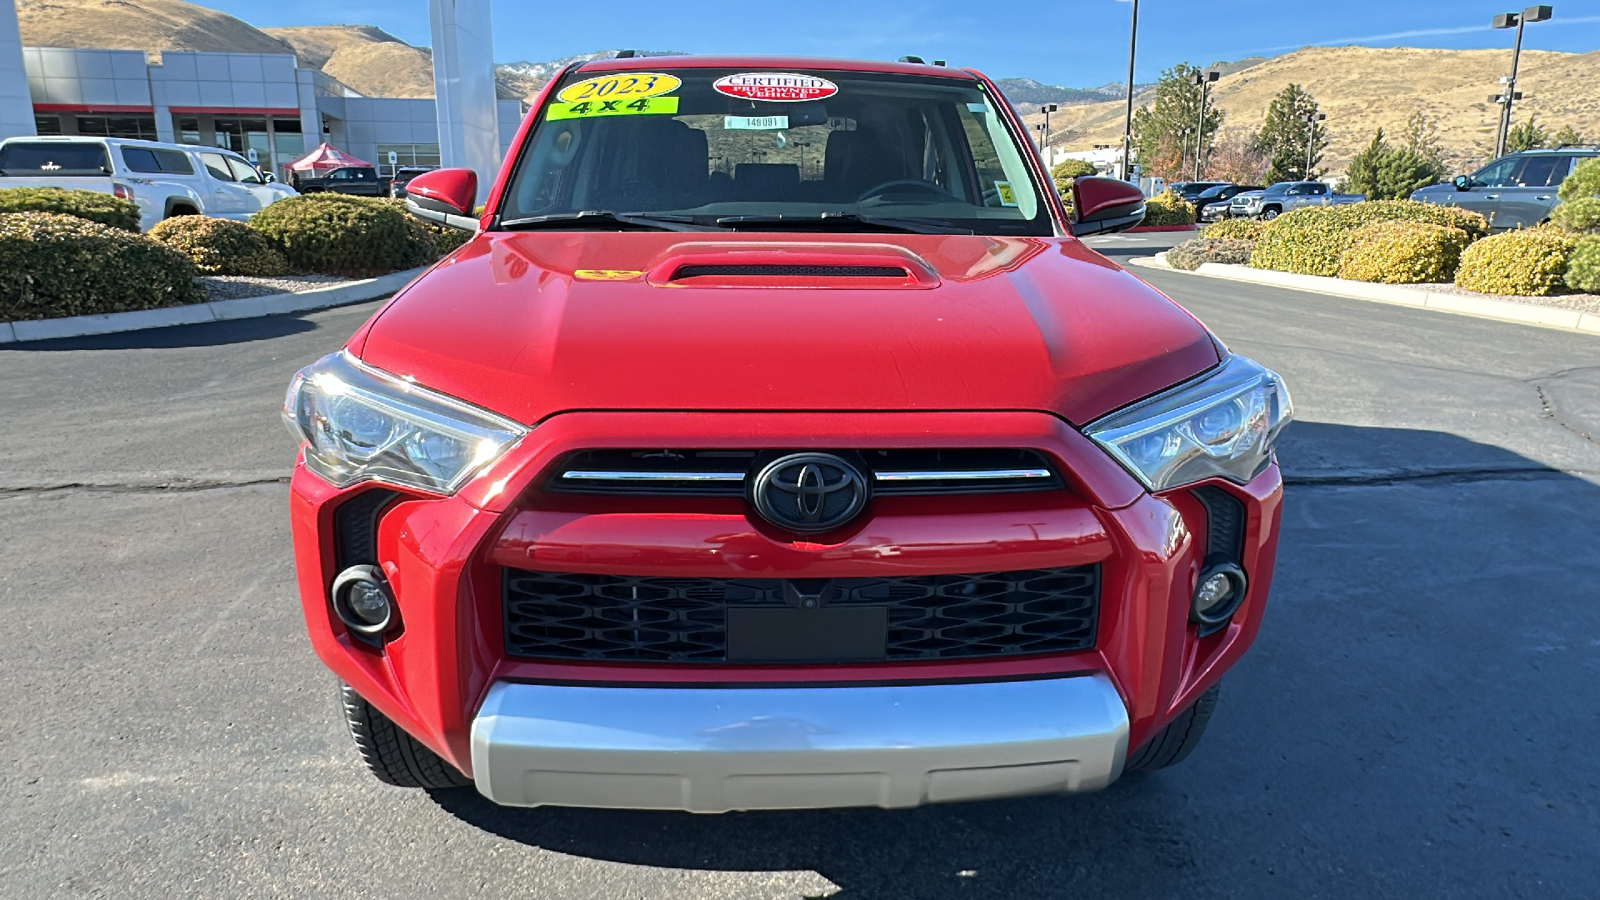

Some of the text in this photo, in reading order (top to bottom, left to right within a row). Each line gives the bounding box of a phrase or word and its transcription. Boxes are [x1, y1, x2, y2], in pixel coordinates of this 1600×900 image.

[729, 77, 823, 87] CERTIFIED
[575, 76, 658, 100] 2023
[733, 86, 820, 94] PRE-OWNED
